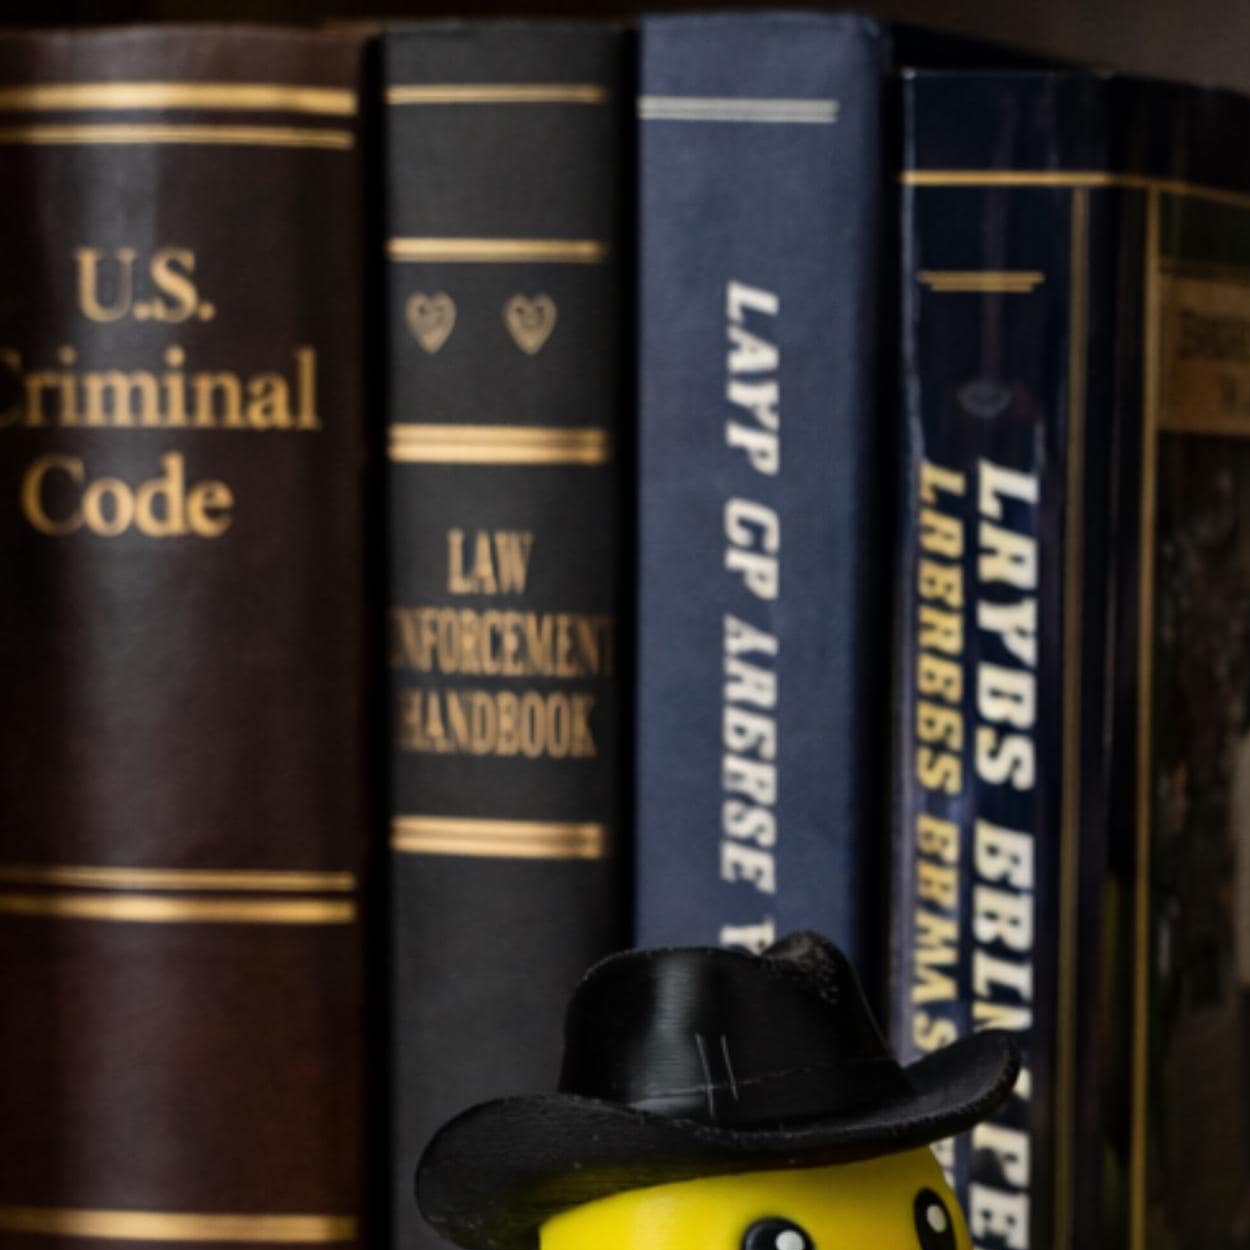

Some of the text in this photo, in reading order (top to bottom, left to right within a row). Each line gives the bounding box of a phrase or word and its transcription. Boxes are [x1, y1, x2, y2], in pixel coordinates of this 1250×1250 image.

[73, 245, 217, 324] U.S.
[20, 450, 235, 539] Code
[446, 526, 535, 597] LAW
